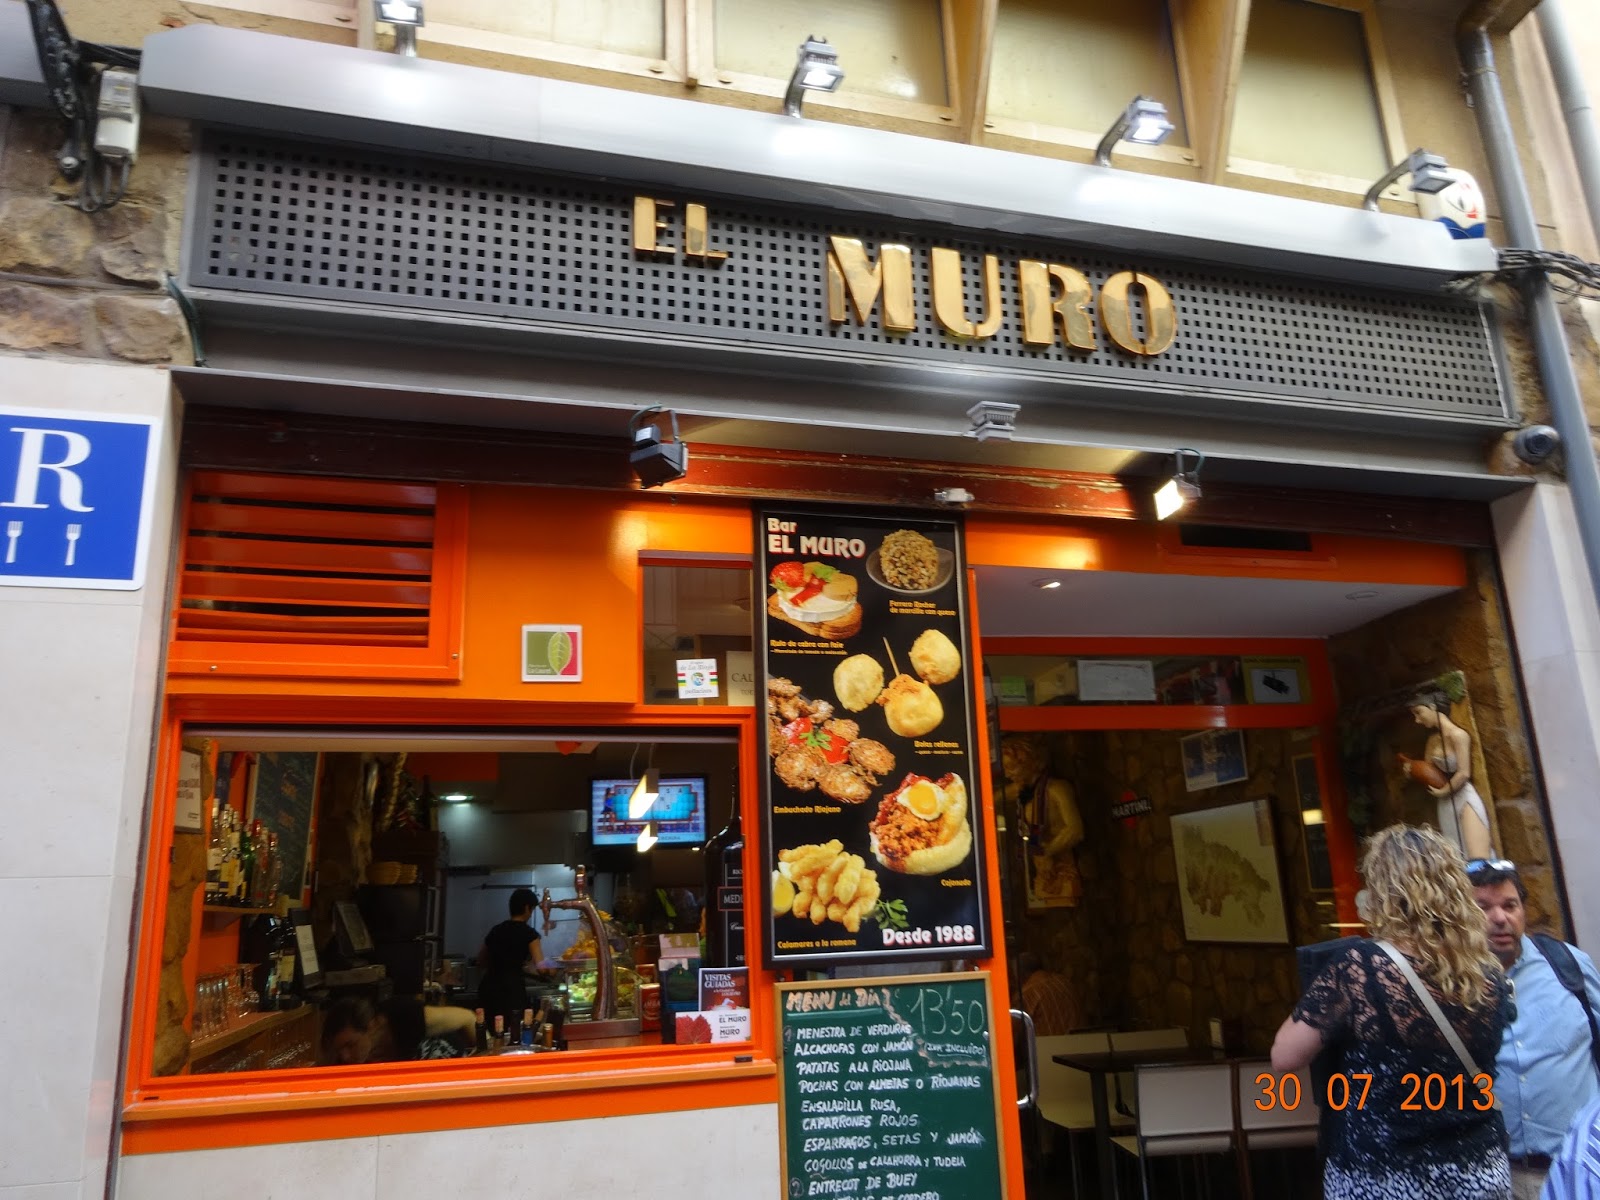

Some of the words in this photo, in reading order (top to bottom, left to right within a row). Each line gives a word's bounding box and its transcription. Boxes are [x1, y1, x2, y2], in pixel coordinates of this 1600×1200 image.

[633, 196, 728, 269] EL
[827, 235, 1178, 357] MURO
[0, 427, 95, 513] R
[767, 518, 797, 533] Bar
[768, 535, 794, 554] EL
[800, 536, 866, 559] MURO
[882, 927, 931, 945] Desde
[935, 925, 975, 944] 1988
[777, 940, 814, 949] Calamares
[704, 980, 736, 988] GUIADAS
[786, 990, 836, 1012] MENU
[728, 1015, 747, 1023] MURO
[720, 1028, 741, 1036] MURO
[797, 1026, 846, 1040] MENESTRA
[849, 1025, 862, 1037] DE
[794, 1042, 854, 1056] ALCACHOFAS
[862, 1042, 879, 1054] CON
[883, 1036, 914, 1053] JAMÓN
[796, 1061, 840, 1076] PATATAS
[798, 1080, 838, 1094] POCHAS
[844, 1080, 864, 1091] CON
[868, 1078, 910, 1091] ALMEJAS
[916, 1079, 925, 1090] O
[802, 1114, 873, 1131] CAPARRONES
[880, 1113, 919, 1127] ROJOS
[881, 1133, 921, 1146] SETAS
[930, 1131, 939, 1143] Y
[870, 1155, 922, 1168] CALAHORRA
[933, 1155, 967, 1168] TUDELA
[808, 1178, 860, 1196] ENTRECOT
[865, 1176, 881, 1190] DE
[886, 1172, 918, 1188] BUEY
